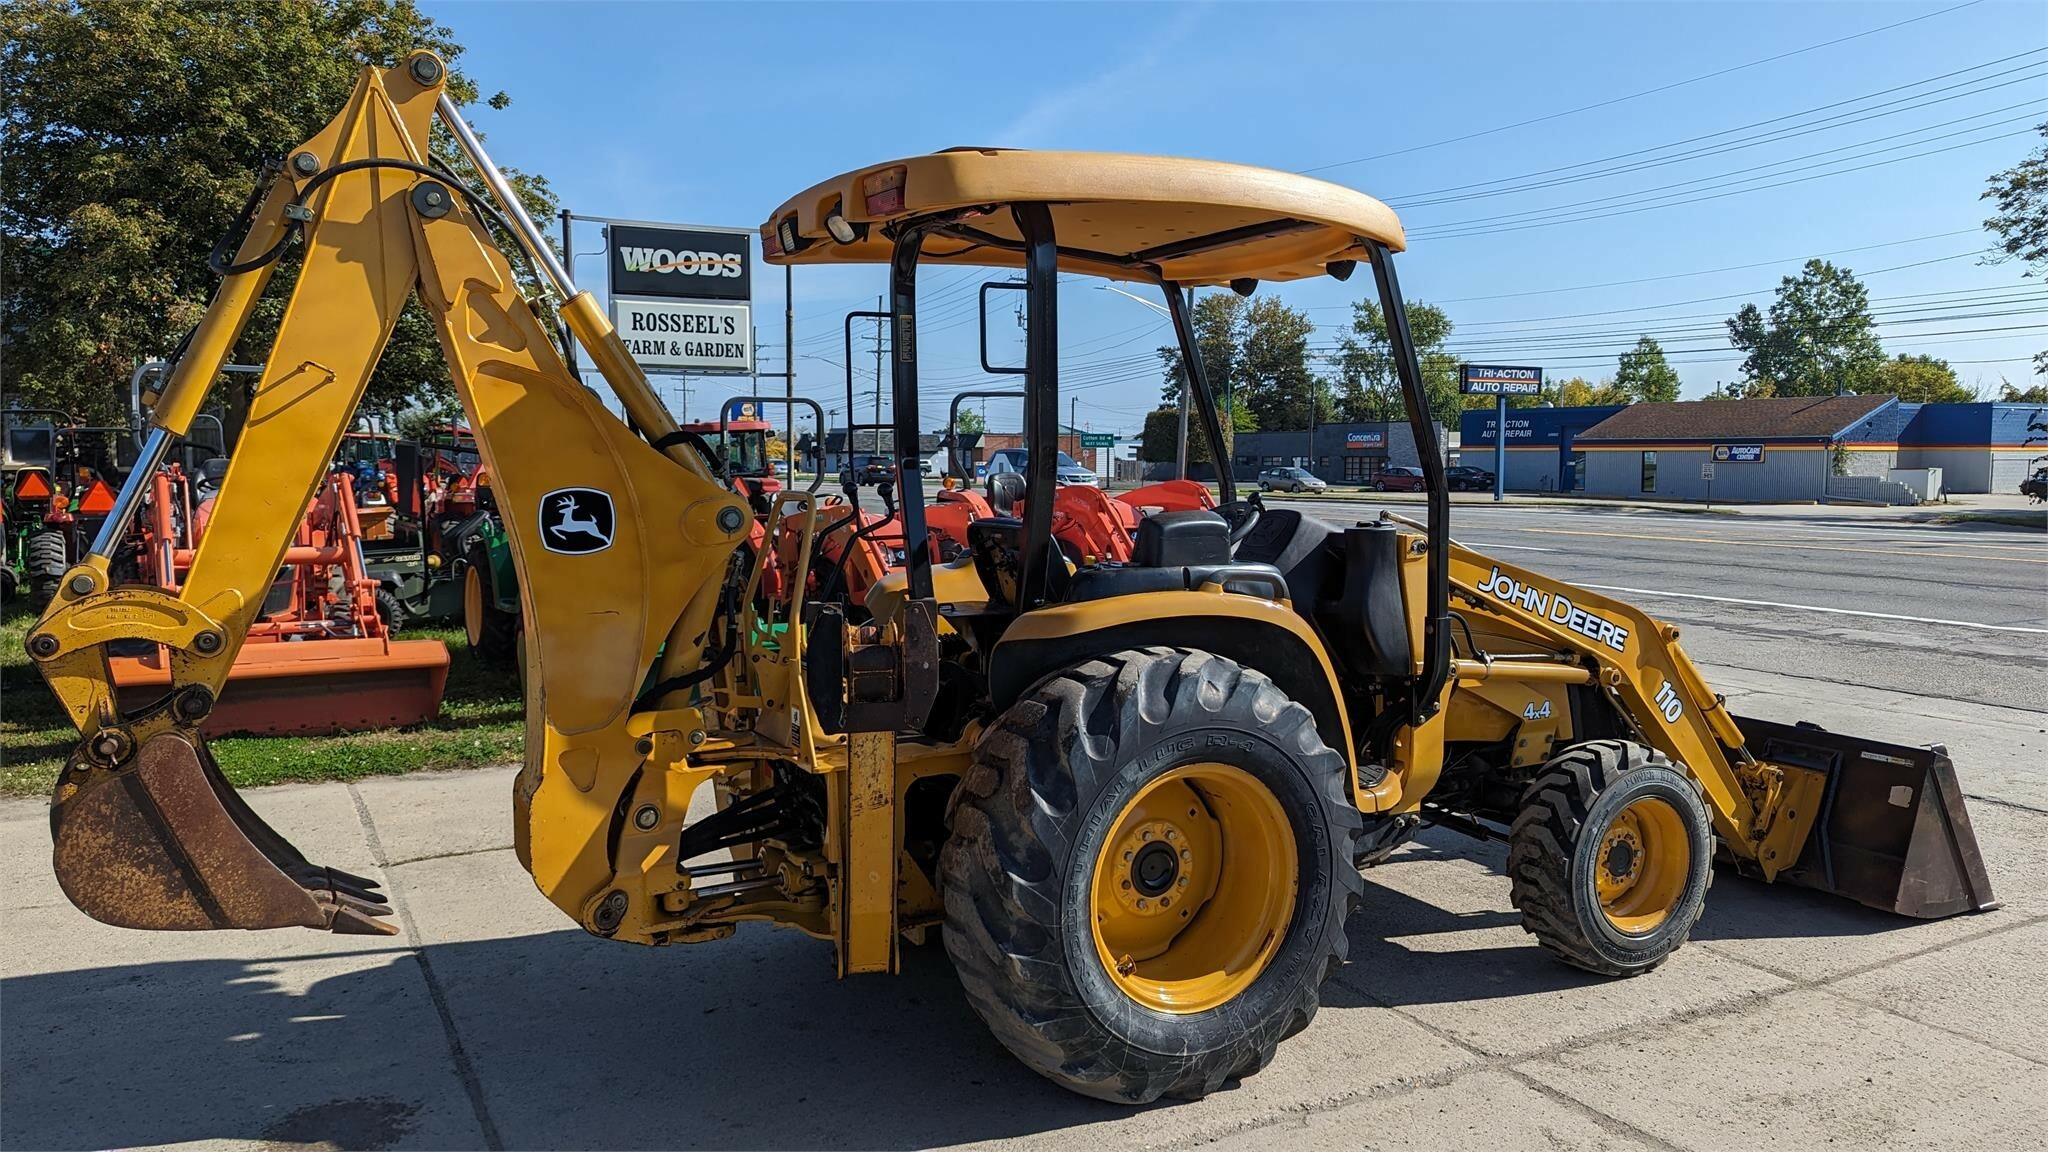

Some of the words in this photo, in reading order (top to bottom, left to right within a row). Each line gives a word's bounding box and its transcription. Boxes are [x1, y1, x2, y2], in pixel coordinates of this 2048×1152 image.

[619, 246, 742, 278] WOODS
[631, 311, 735, 335] ROSSEEL'S
[669, 341, 681, 356] &
[684, 341, 745, 359] GARDEN
[1478, 369, 1534, 379] TRI-ACTION
[1471, 382, 1500, 392] AUTO
[1502, 383, 1539, 393] REPAIR
[1486, 420, 1530, 428] TRCTION
[1482, 430, 1497, 438] AUT
[1504, 430, 1532, 438] REPAIR
[1477, 565, 1549, 617] JOHN
[1549, 592, 1630, 653] DEERE
[1523, 700, 1551, 720] 4x4
[1654, 679, 1684, 723] 110
